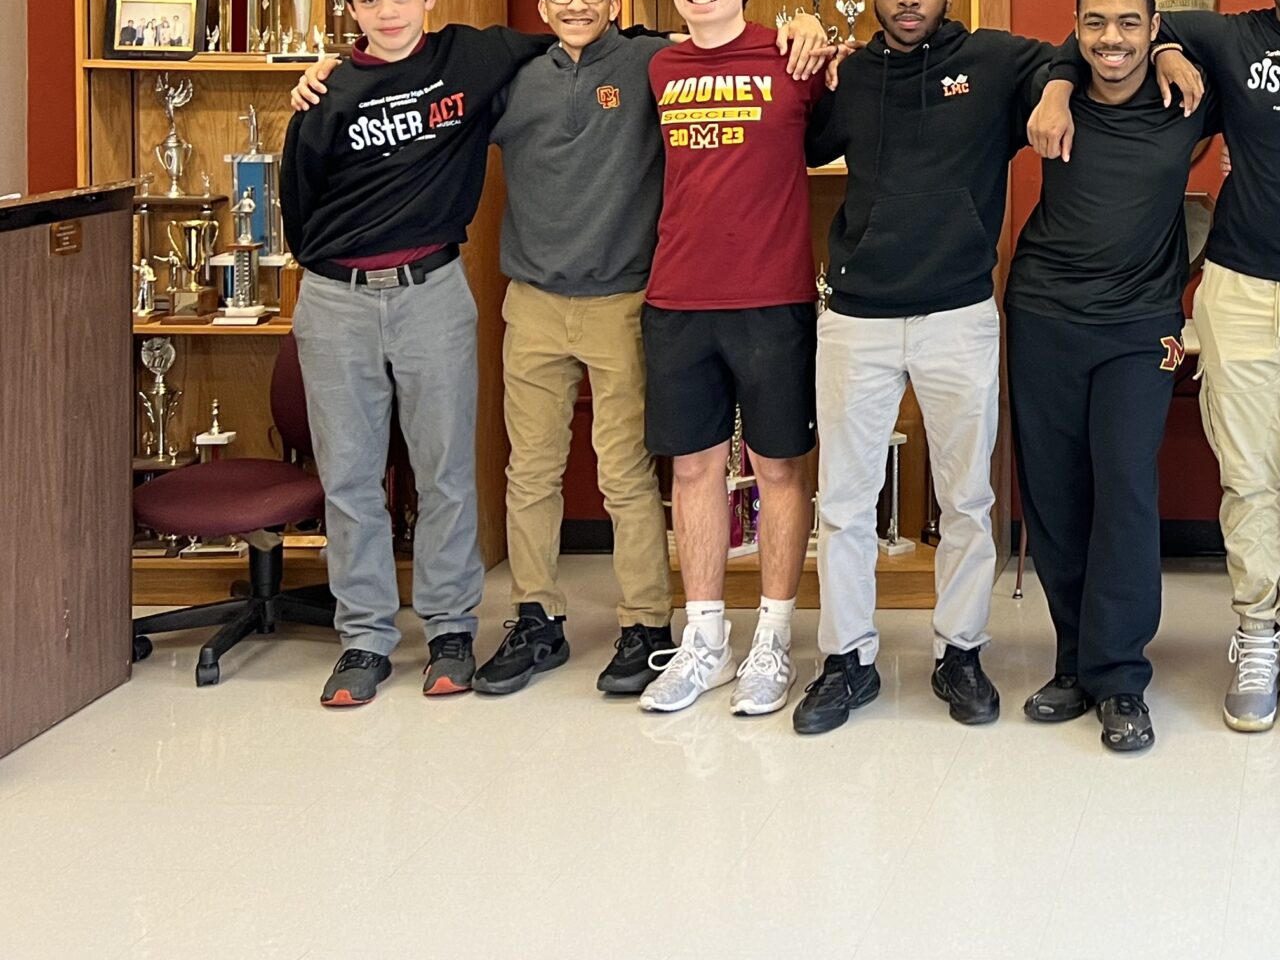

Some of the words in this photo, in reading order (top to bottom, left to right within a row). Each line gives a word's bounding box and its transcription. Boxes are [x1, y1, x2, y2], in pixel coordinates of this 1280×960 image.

[658, 75, 773, 106] MOONEY
[943, 83, 970, 97] LMC
[348, 107, 423, 151] SISTER
[429, 92, 465, 129] ACT
[663, 110, 752, 121] SOCCER
[669, 129, 689, 147] 20
[689, 123, 719, 149] M
[721, 126, 744, 145] 23
